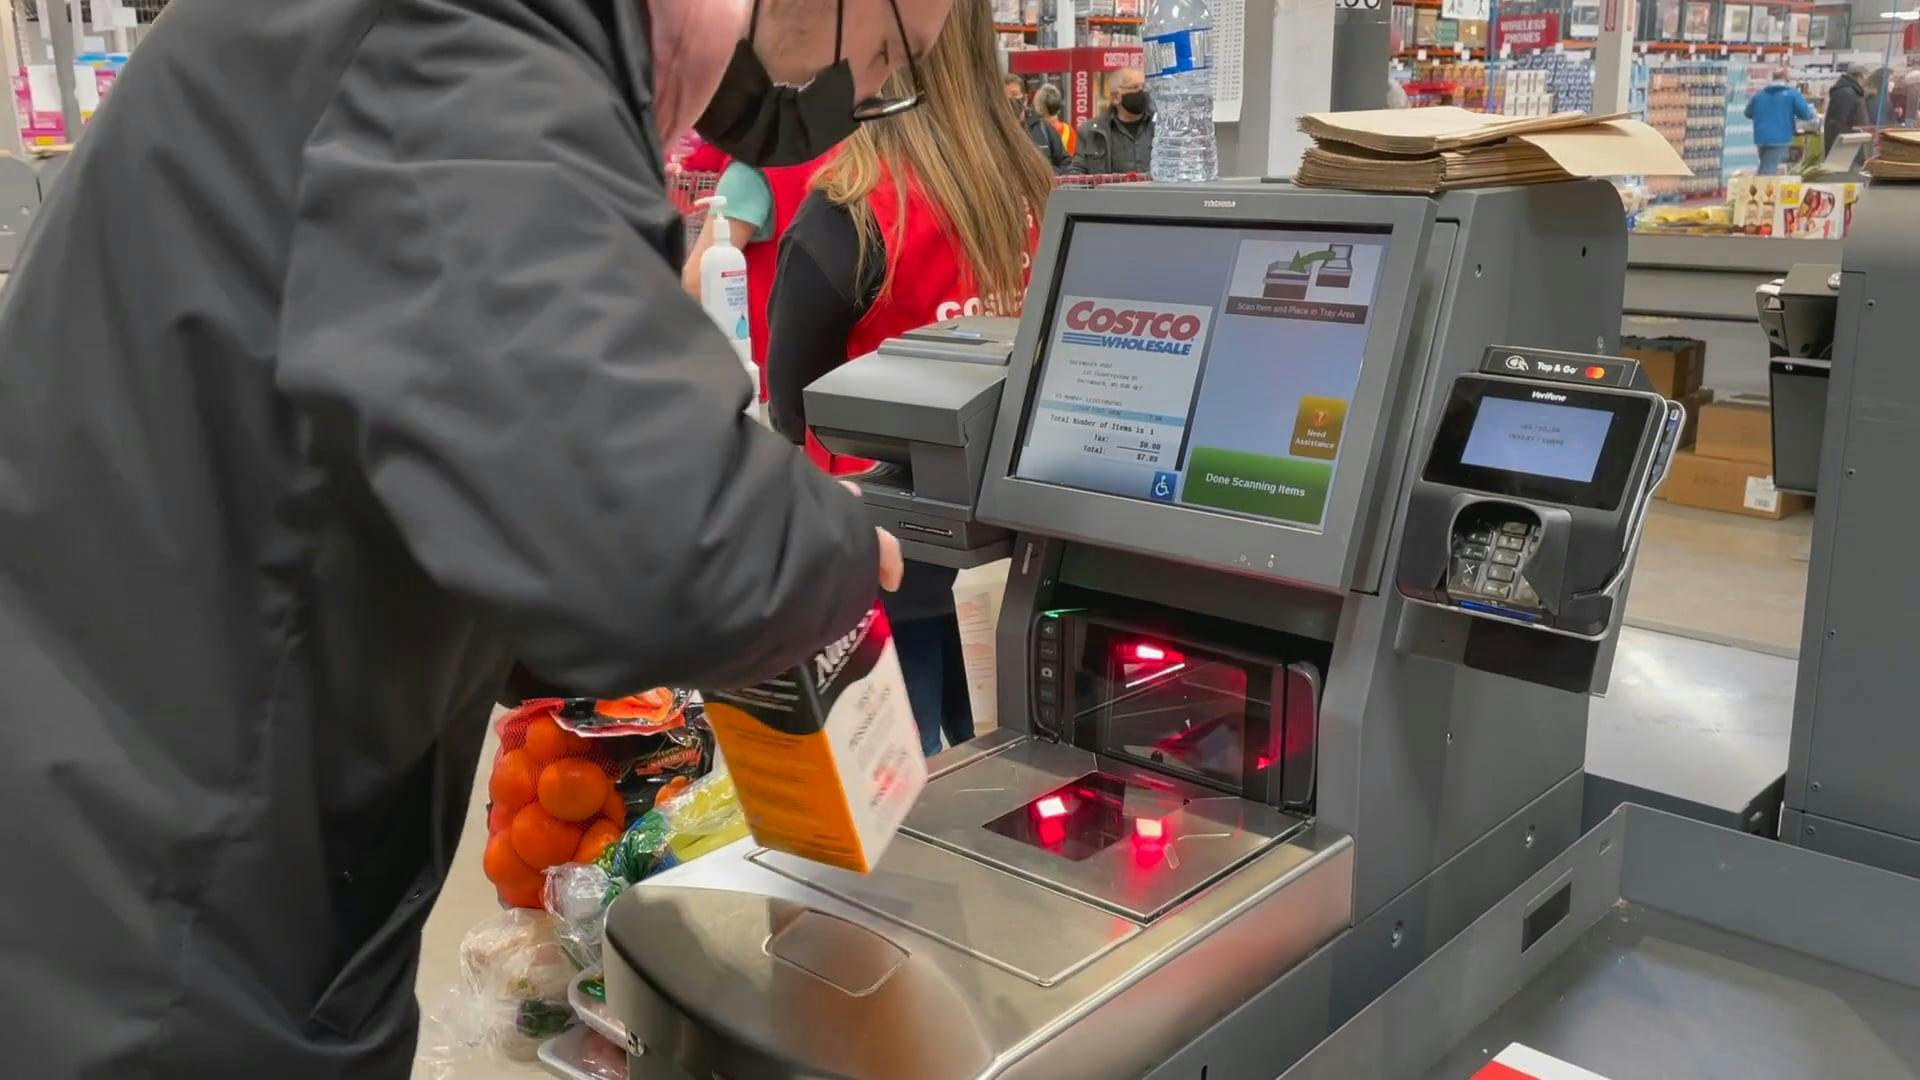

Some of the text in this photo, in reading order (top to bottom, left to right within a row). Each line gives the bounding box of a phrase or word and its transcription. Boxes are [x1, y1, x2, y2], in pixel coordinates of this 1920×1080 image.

[1500, 19, 1547, 32] WIRELESS
[1504, 32, 1541, 44] PHONES
[1103, 52, 1130, 67] COSTCO
[1076, 70, 1088, 113] COSTCO
[1236, 302, 1255, 312] Scan
[1273, 305, 1288, 313] and
[1288, 305, 1309, 315] Place
[1319, 307, 1337, 319] Tray
[1338, 309, 1355, 319] Area
[1066, 300, 1201, 341] COSTCO
[1101, 335, 1193, 356] WHOLESALE
[1537, 361, 1577, 374] Tap & Go
[1532, 391, 1566, 401] Verifone
[1050, 413, 1069, 424] Total
[1072, 416, 1096, 427] Number
[1099, 420, 1109, 429] of
[1111, 422, 1133, 433] Items
[1136, 424, 1145, 434] is
[1306, 428, 1327, 439] Need
[1138, 440, 1162, 451] $0.00
[1295, 438, 1335, 449] Assistance
[1205, 471, 1306, 497] Done Scanning Items
